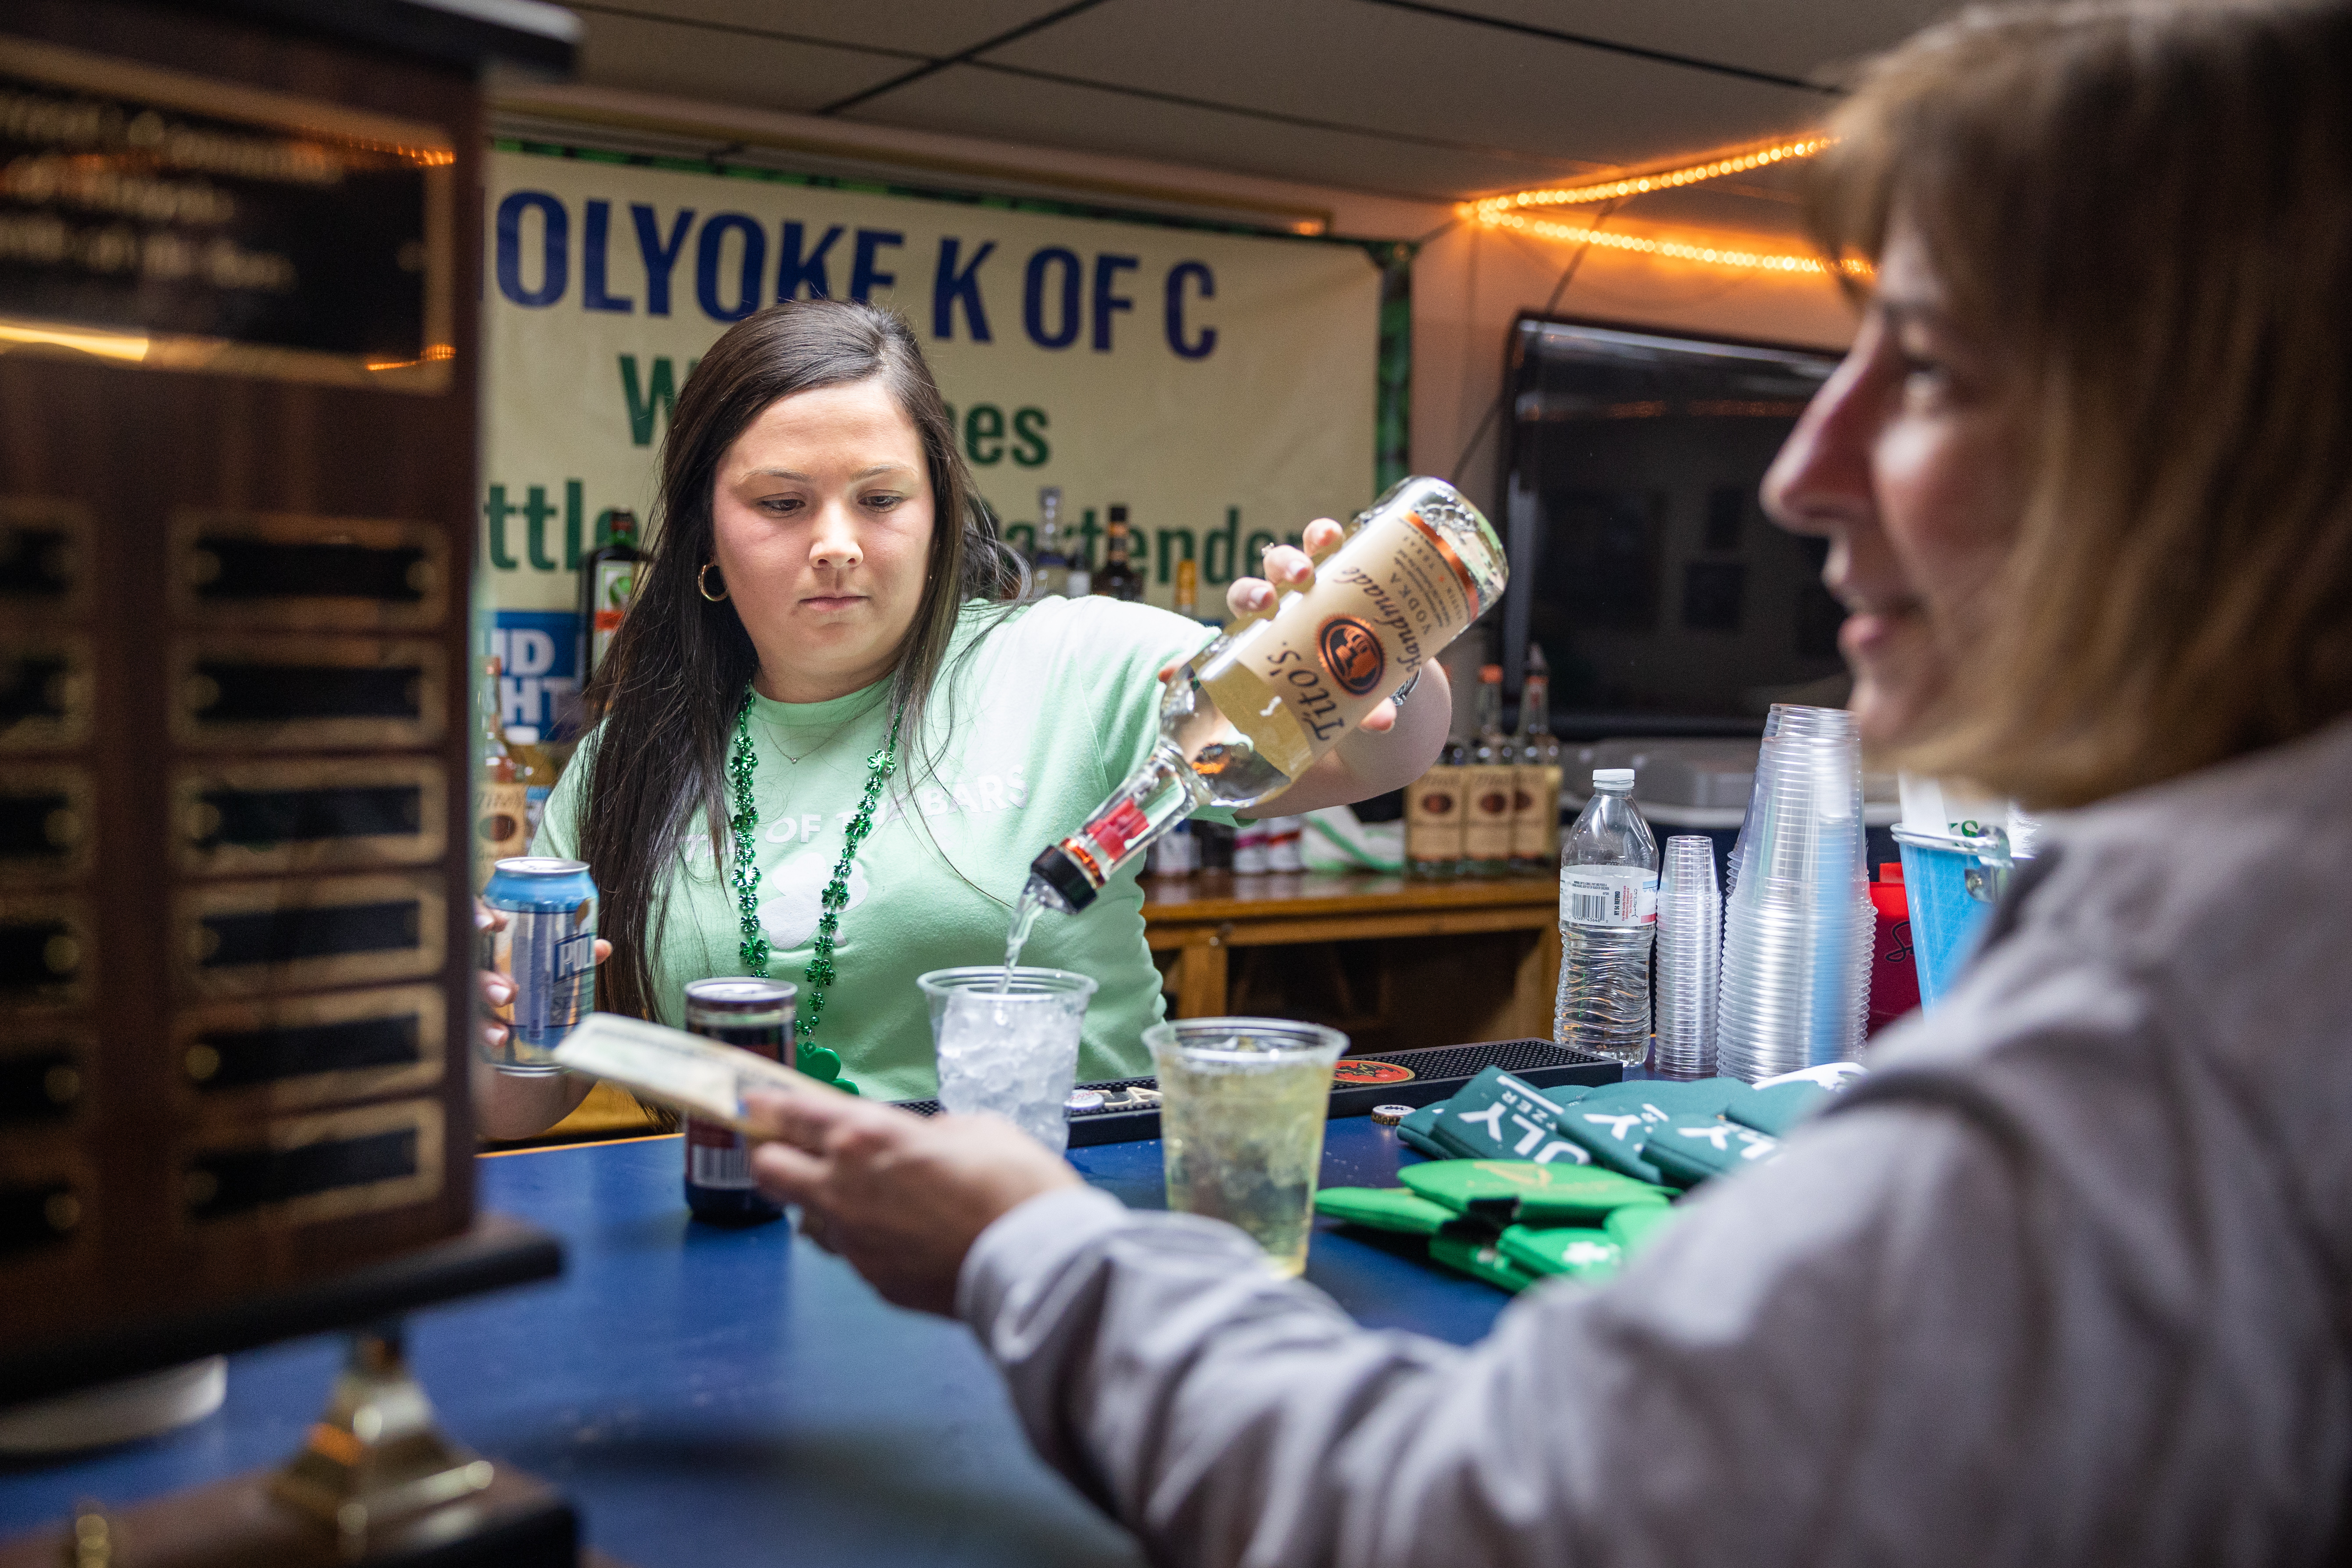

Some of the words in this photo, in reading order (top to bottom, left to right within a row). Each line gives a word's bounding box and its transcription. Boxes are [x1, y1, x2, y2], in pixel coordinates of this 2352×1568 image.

[496, 189, 905, 322] OLYOKE
[932, 237, 998, 344] K
[1024, 246, 1139, 354] OF
[1164, 260, 1219, 360] C
[1334, 567, 1421, 674] Handmade
[1390, 572, 1432, 635] VODKA
[765, 814, 822, 844] OF
[923, 764, 1029, 818] BARS
